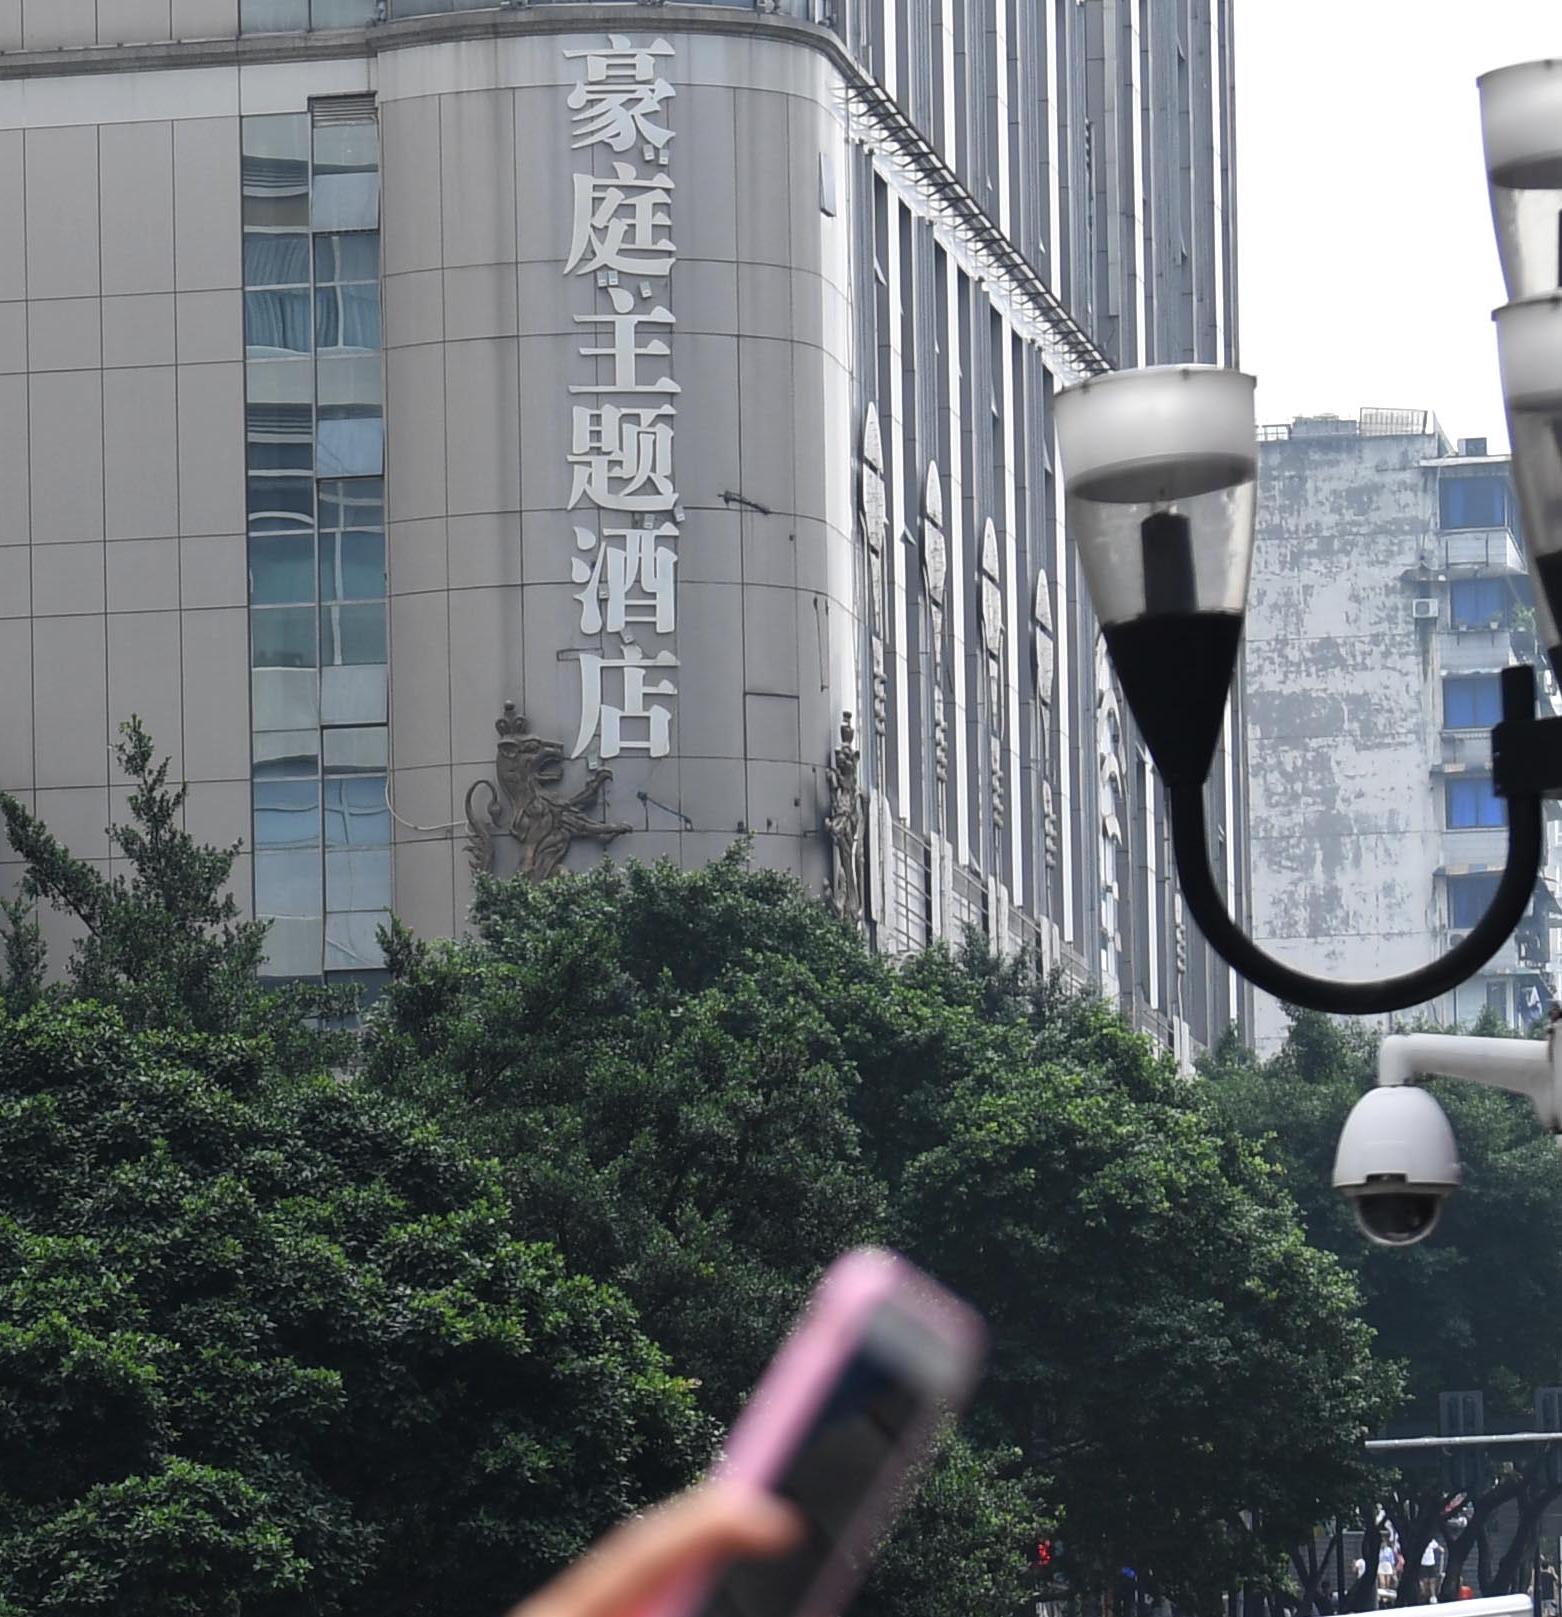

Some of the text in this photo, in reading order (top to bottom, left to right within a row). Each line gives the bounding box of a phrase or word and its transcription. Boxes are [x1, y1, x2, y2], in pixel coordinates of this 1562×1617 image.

[563, 34, 681, 760] 豪庭主题酒店
